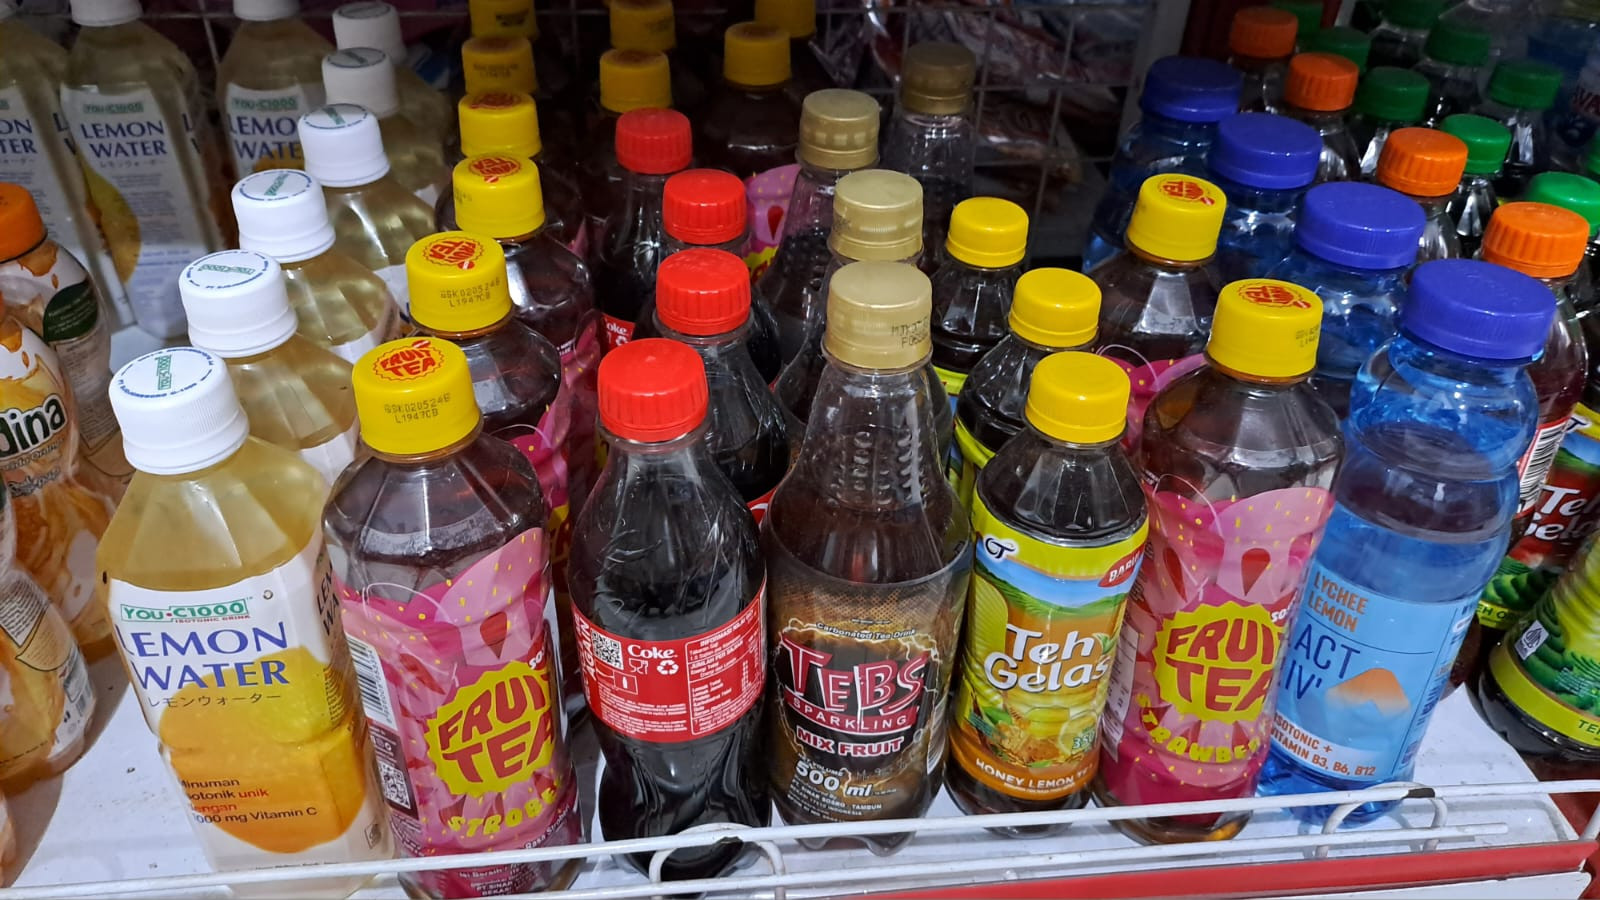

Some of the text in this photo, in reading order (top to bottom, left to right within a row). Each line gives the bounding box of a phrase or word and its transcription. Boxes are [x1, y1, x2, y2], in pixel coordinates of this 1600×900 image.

[80, 120, 165, 140] LEMON
[89, 140, 168, 159] WATER
[380, 348, 432, 370] FRUIT
[384, 356, 437, 377] TEA
[1313, 570, 1368, 615] LYCHEE
[1307, 591, 1358, 633] LEMON
[114, 621, 288, 657] LEMON
[627, 645, 676, 659] Coke
[1005, 624, 1096, 664] Teh
[1294, 623, 1360, 680] ACT
[130, 660, 290, 691] WATER
[983, 651, 1111, 693] Gelas
[148, 692, 281, 709] レモンウォーター
[792, 698, 908, 731] SPARKLING
[796, 725, 905, 757] MIX FRUIT
[1272, 712, 1321, 750] ISOTONIC
[444, 718, 553, 783] TEA
[1271, 727, 1376, 776] VITAMIN B3, B6, B12
[796, 761, 840, 791] 500
[846, 784, 873, 797] ml
[975, 757, 1025, 786] HONEY
[1028, 775, 1075, 789] LEMON
[238, 787, 269, 798] unik
[225, 813, 248, 824] mg
[249, 808, 303, 821] Vitamin
[306, 806, 318, 816] C
